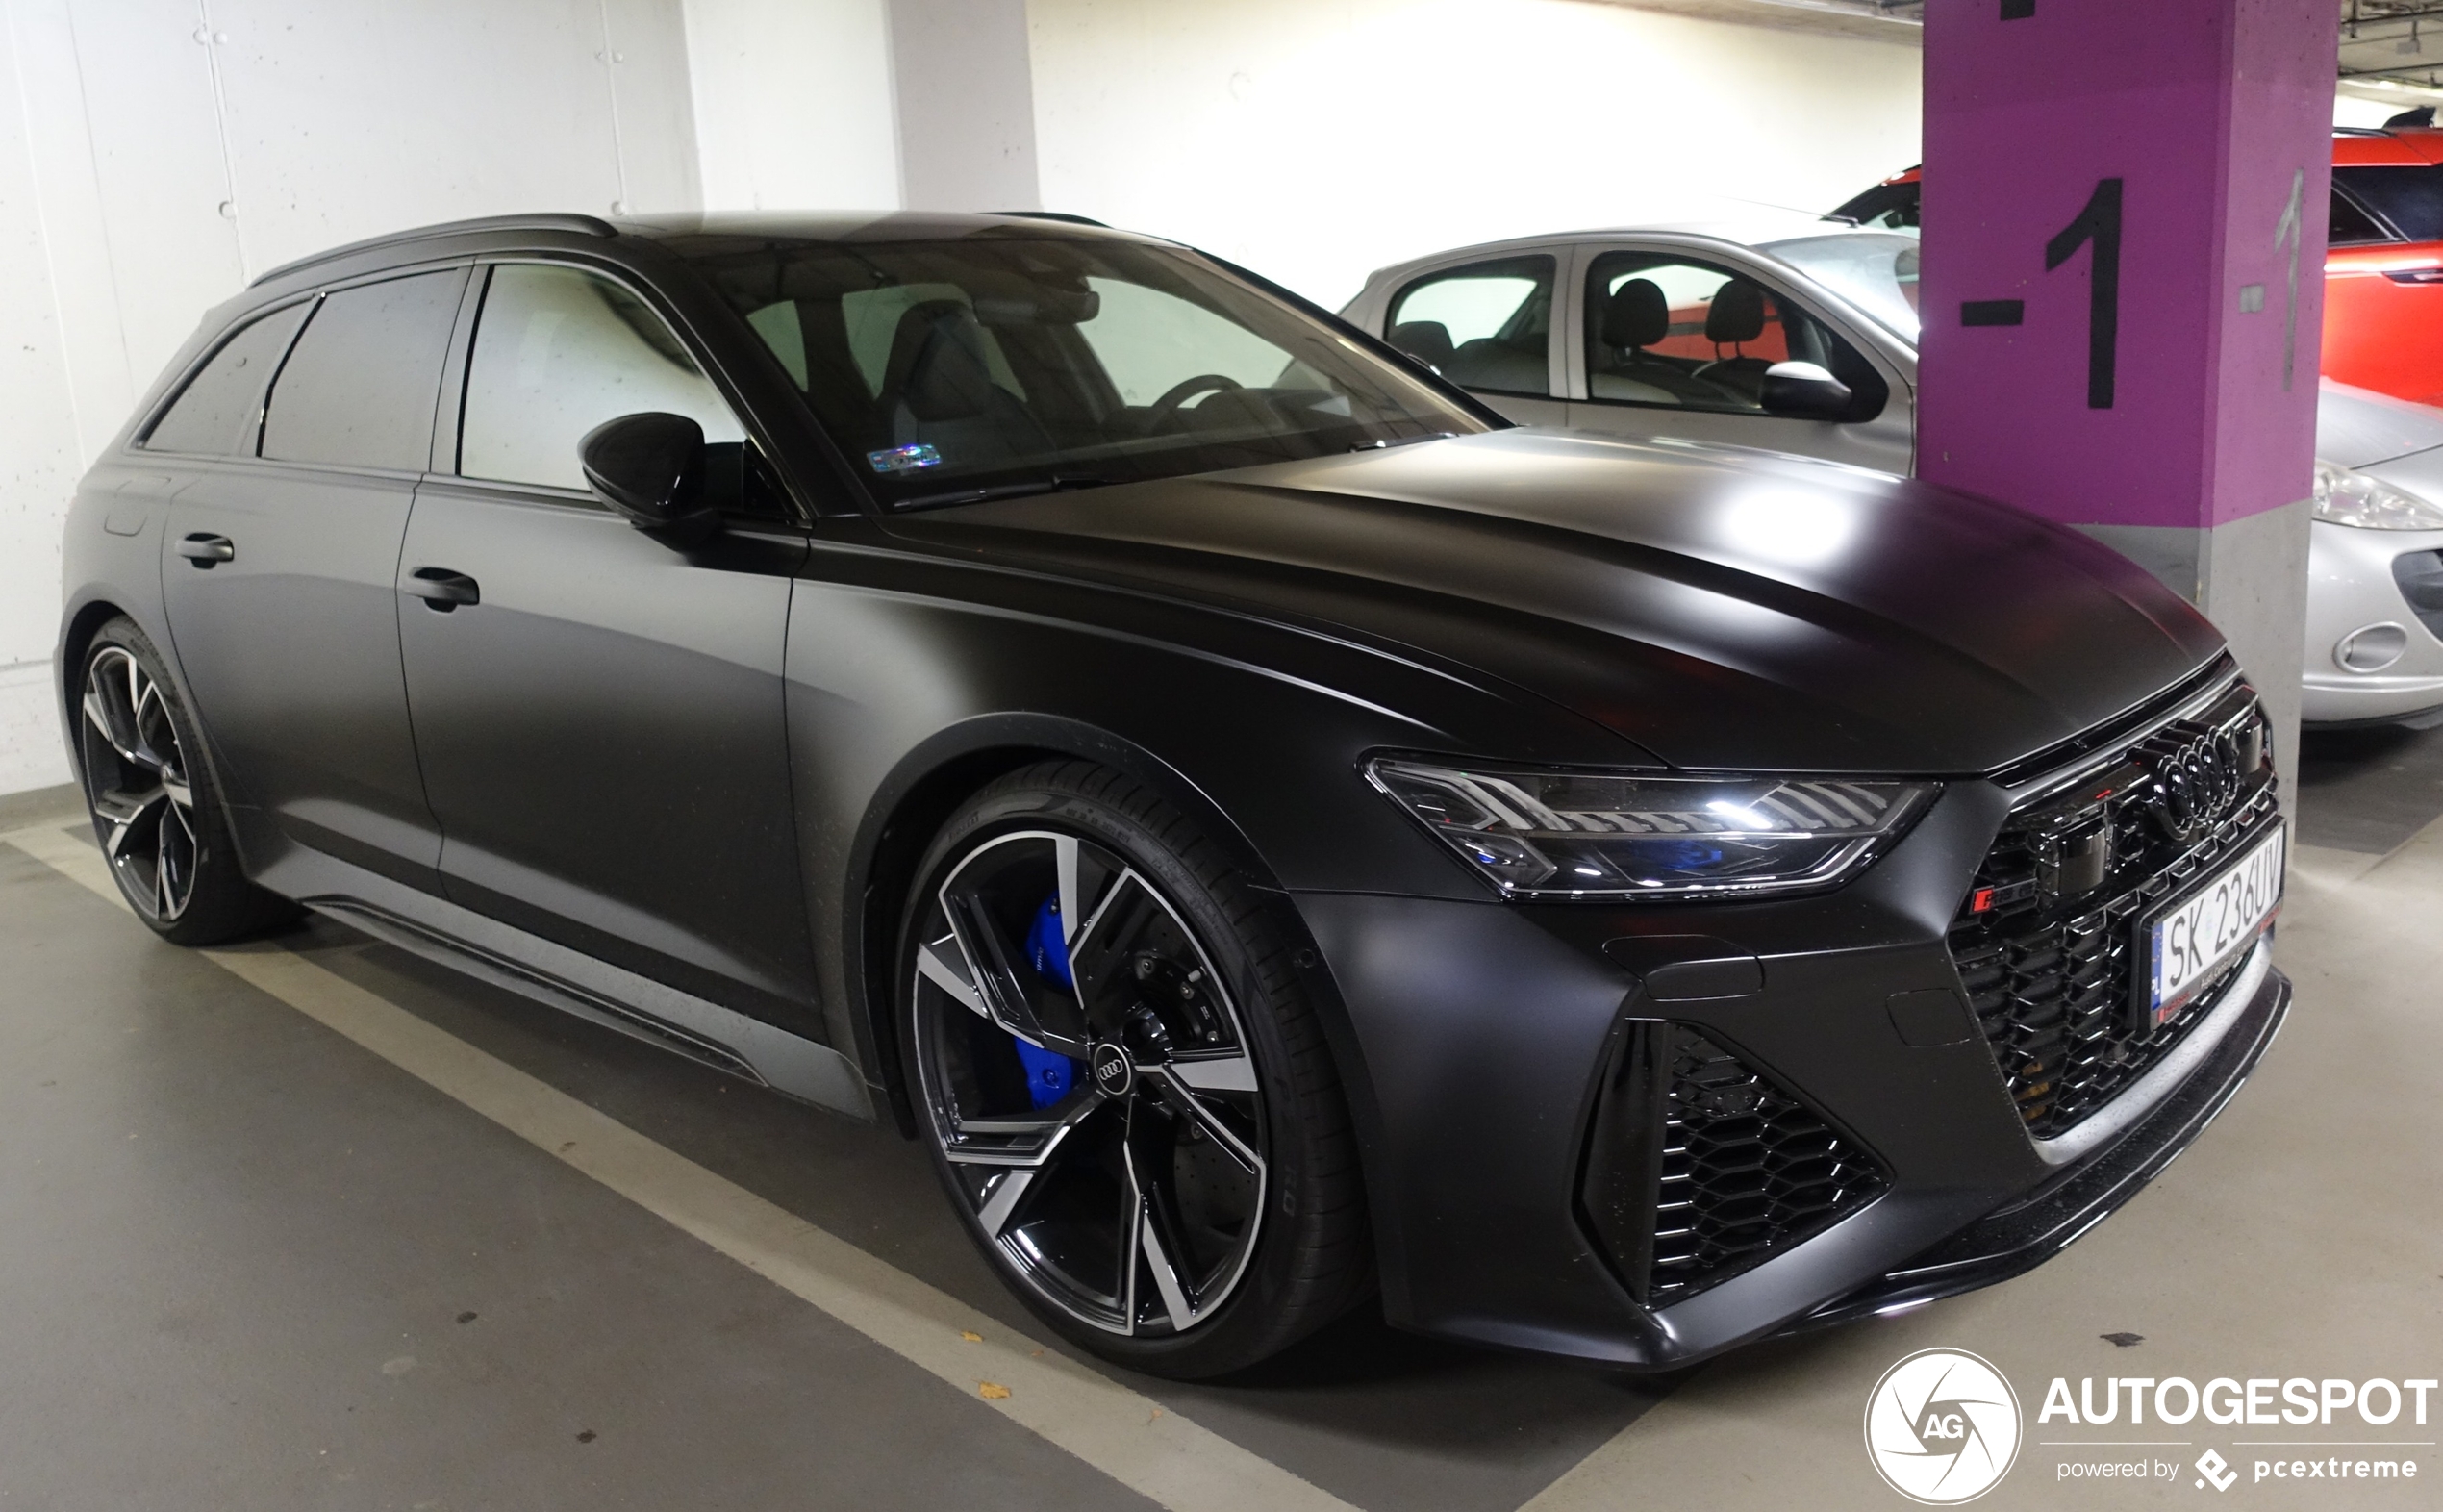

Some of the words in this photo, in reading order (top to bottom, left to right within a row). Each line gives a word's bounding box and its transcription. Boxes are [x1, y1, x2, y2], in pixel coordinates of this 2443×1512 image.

[1960, 177, 2123, 410] -1
[2170, 897, 2204, 987] SK
[2215, 834, 2280, 956] 236UV
